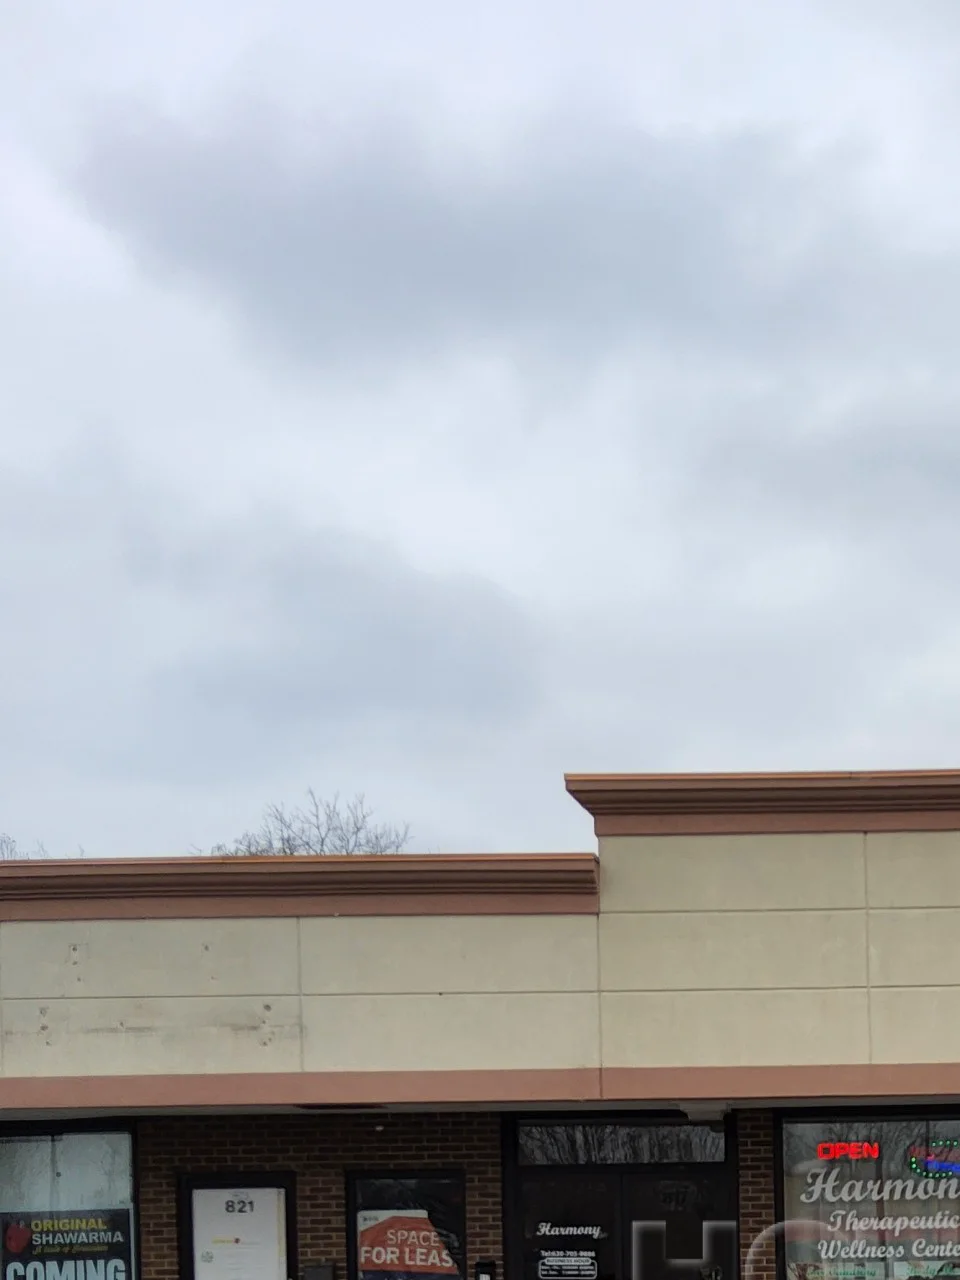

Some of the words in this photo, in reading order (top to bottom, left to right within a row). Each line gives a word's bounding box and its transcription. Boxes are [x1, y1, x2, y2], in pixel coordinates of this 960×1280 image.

[817, 1143, 879, 1160] OPEN
[225, 1200, 254, 1213] 821
[31, 1218, 107, 1232] ORIGINAL
[536, 1221, 601, 1239] Harmony
[827, 1210, 960, 1236] Therapeutic
[32, 1231, 124, 1245] SHAWARMA
[386, 1229, 441, 1246] SPACE
[360, 1246, 399, 1264] FOR
[404, 1248, 456, 1268] LEAS
[817, 1239, 904, 1259] Wellness
